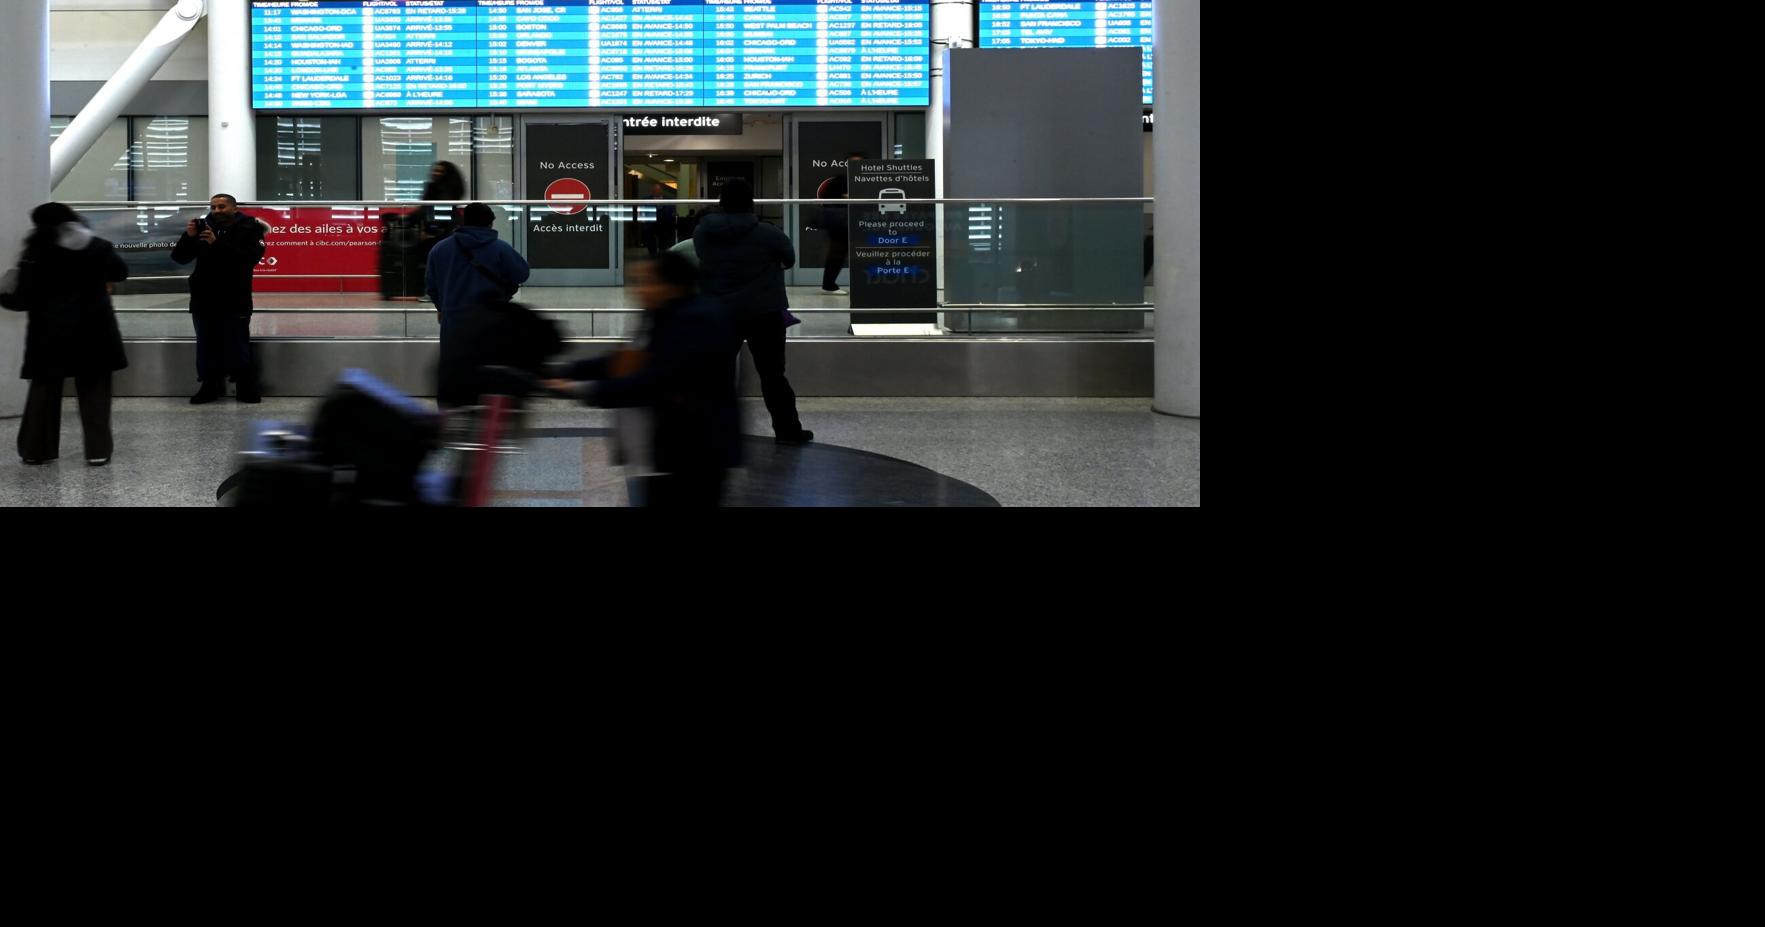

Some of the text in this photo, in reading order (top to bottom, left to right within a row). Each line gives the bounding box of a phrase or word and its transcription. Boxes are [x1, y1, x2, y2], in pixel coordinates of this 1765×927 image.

[661, 116, 720, 128] interdite
[540, 161, 595, 170] No Access
[812, 159, 827, 167] No
[290, 224, 311, 234] des
[315, 224, 343, 234] ailes
[346, 223, 353, 234] à
[357, 226, 377, 234] vos
[533, 223, 603, 234] Accès interdit
[890, 221, 924, 229] proceed
[892, 250, 930, 259] procéder
